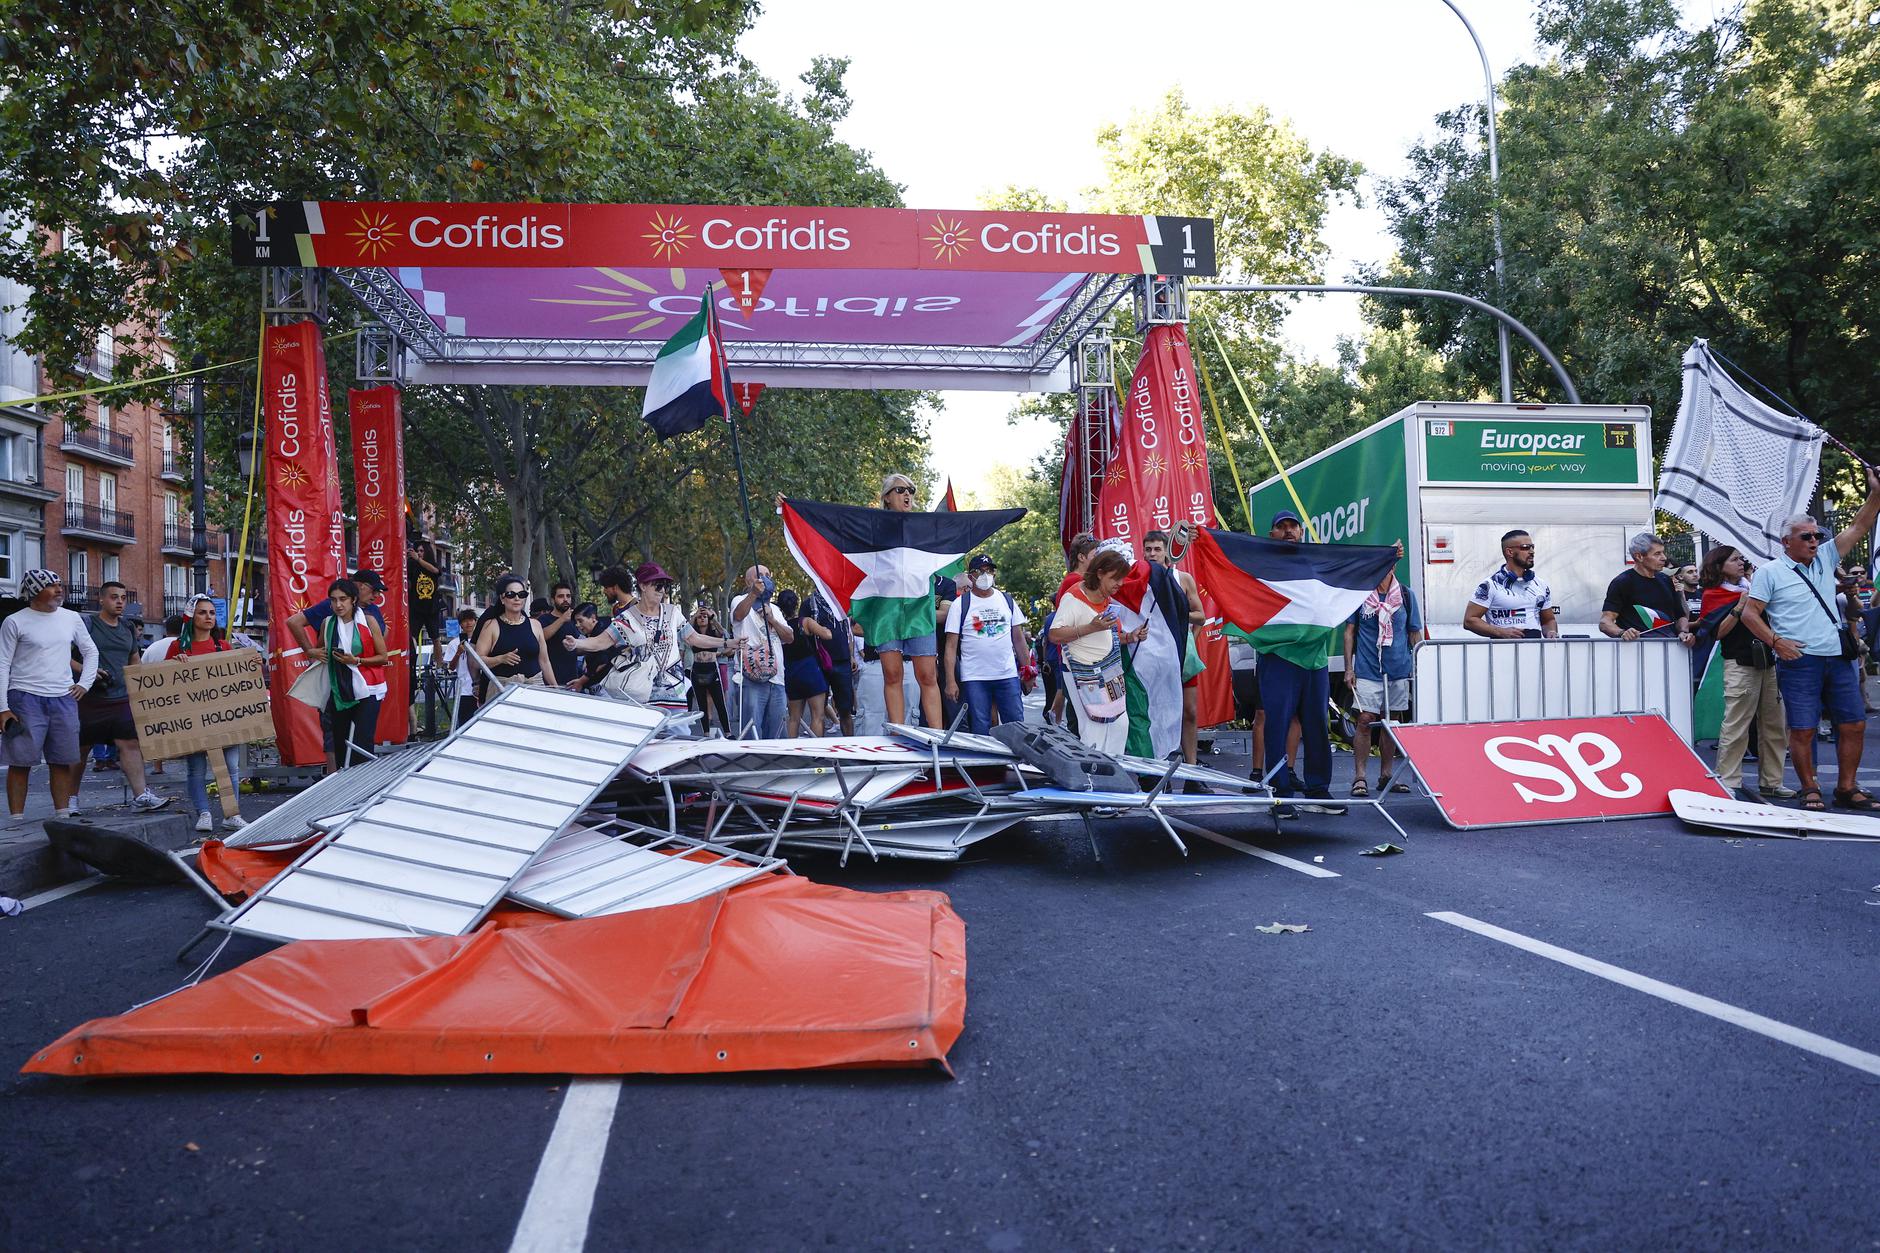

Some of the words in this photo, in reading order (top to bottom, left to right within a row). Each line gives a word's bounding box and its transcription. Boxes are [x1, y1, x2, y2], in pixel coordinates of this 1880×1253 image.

[255, 209, 271, 242] 1
[408, 215, 565, 249] Cofidis
[701, 218, 851, 251] Cofidis
[980, 222, 1121, 257] Cofidis
[1182, 224, 1196, 255] 1
[255, 245, 271, 258] KM
[1183, 257, 1196, 270] KM
[741, 271, 752, 295] 1
[741, 298, 752, 307] KM
[742, 382, 751, 400] 1
[1172, 367, 1195, 445] Cofidis
[277, 373, 300, 457] Cofidis
[1134, 375, 1158, 449] Cofidis
[1480, 428, 1585, 455] Europcar
[1615, 434, 1625, 446] 13
[362, 429, 380, 497] Cofidis
[1481, 462, 1526, 474] moving
[1527, 464, 1557, 475] your
[1560, 463, 1587, 474] way
[1111, 503, 1131, 540] idis
[284, 509, 309, 594] Cofidis
[329, 510, 342, 580] ofidis
[368, 539, 386, 608] Cidis
[132, 673, 164, 691] YOU
[173, 668, 200, 686] ARE
[205, 659, 258, 680] KILLING
[138, 694, 181, 711] THOSE
[187, 688, 219, 703] WHO
[220, 680, 254, 698] SAVED
[144, 717, 193, 737] DURING
[201, 701, 269, 728] HOLOCAUST
